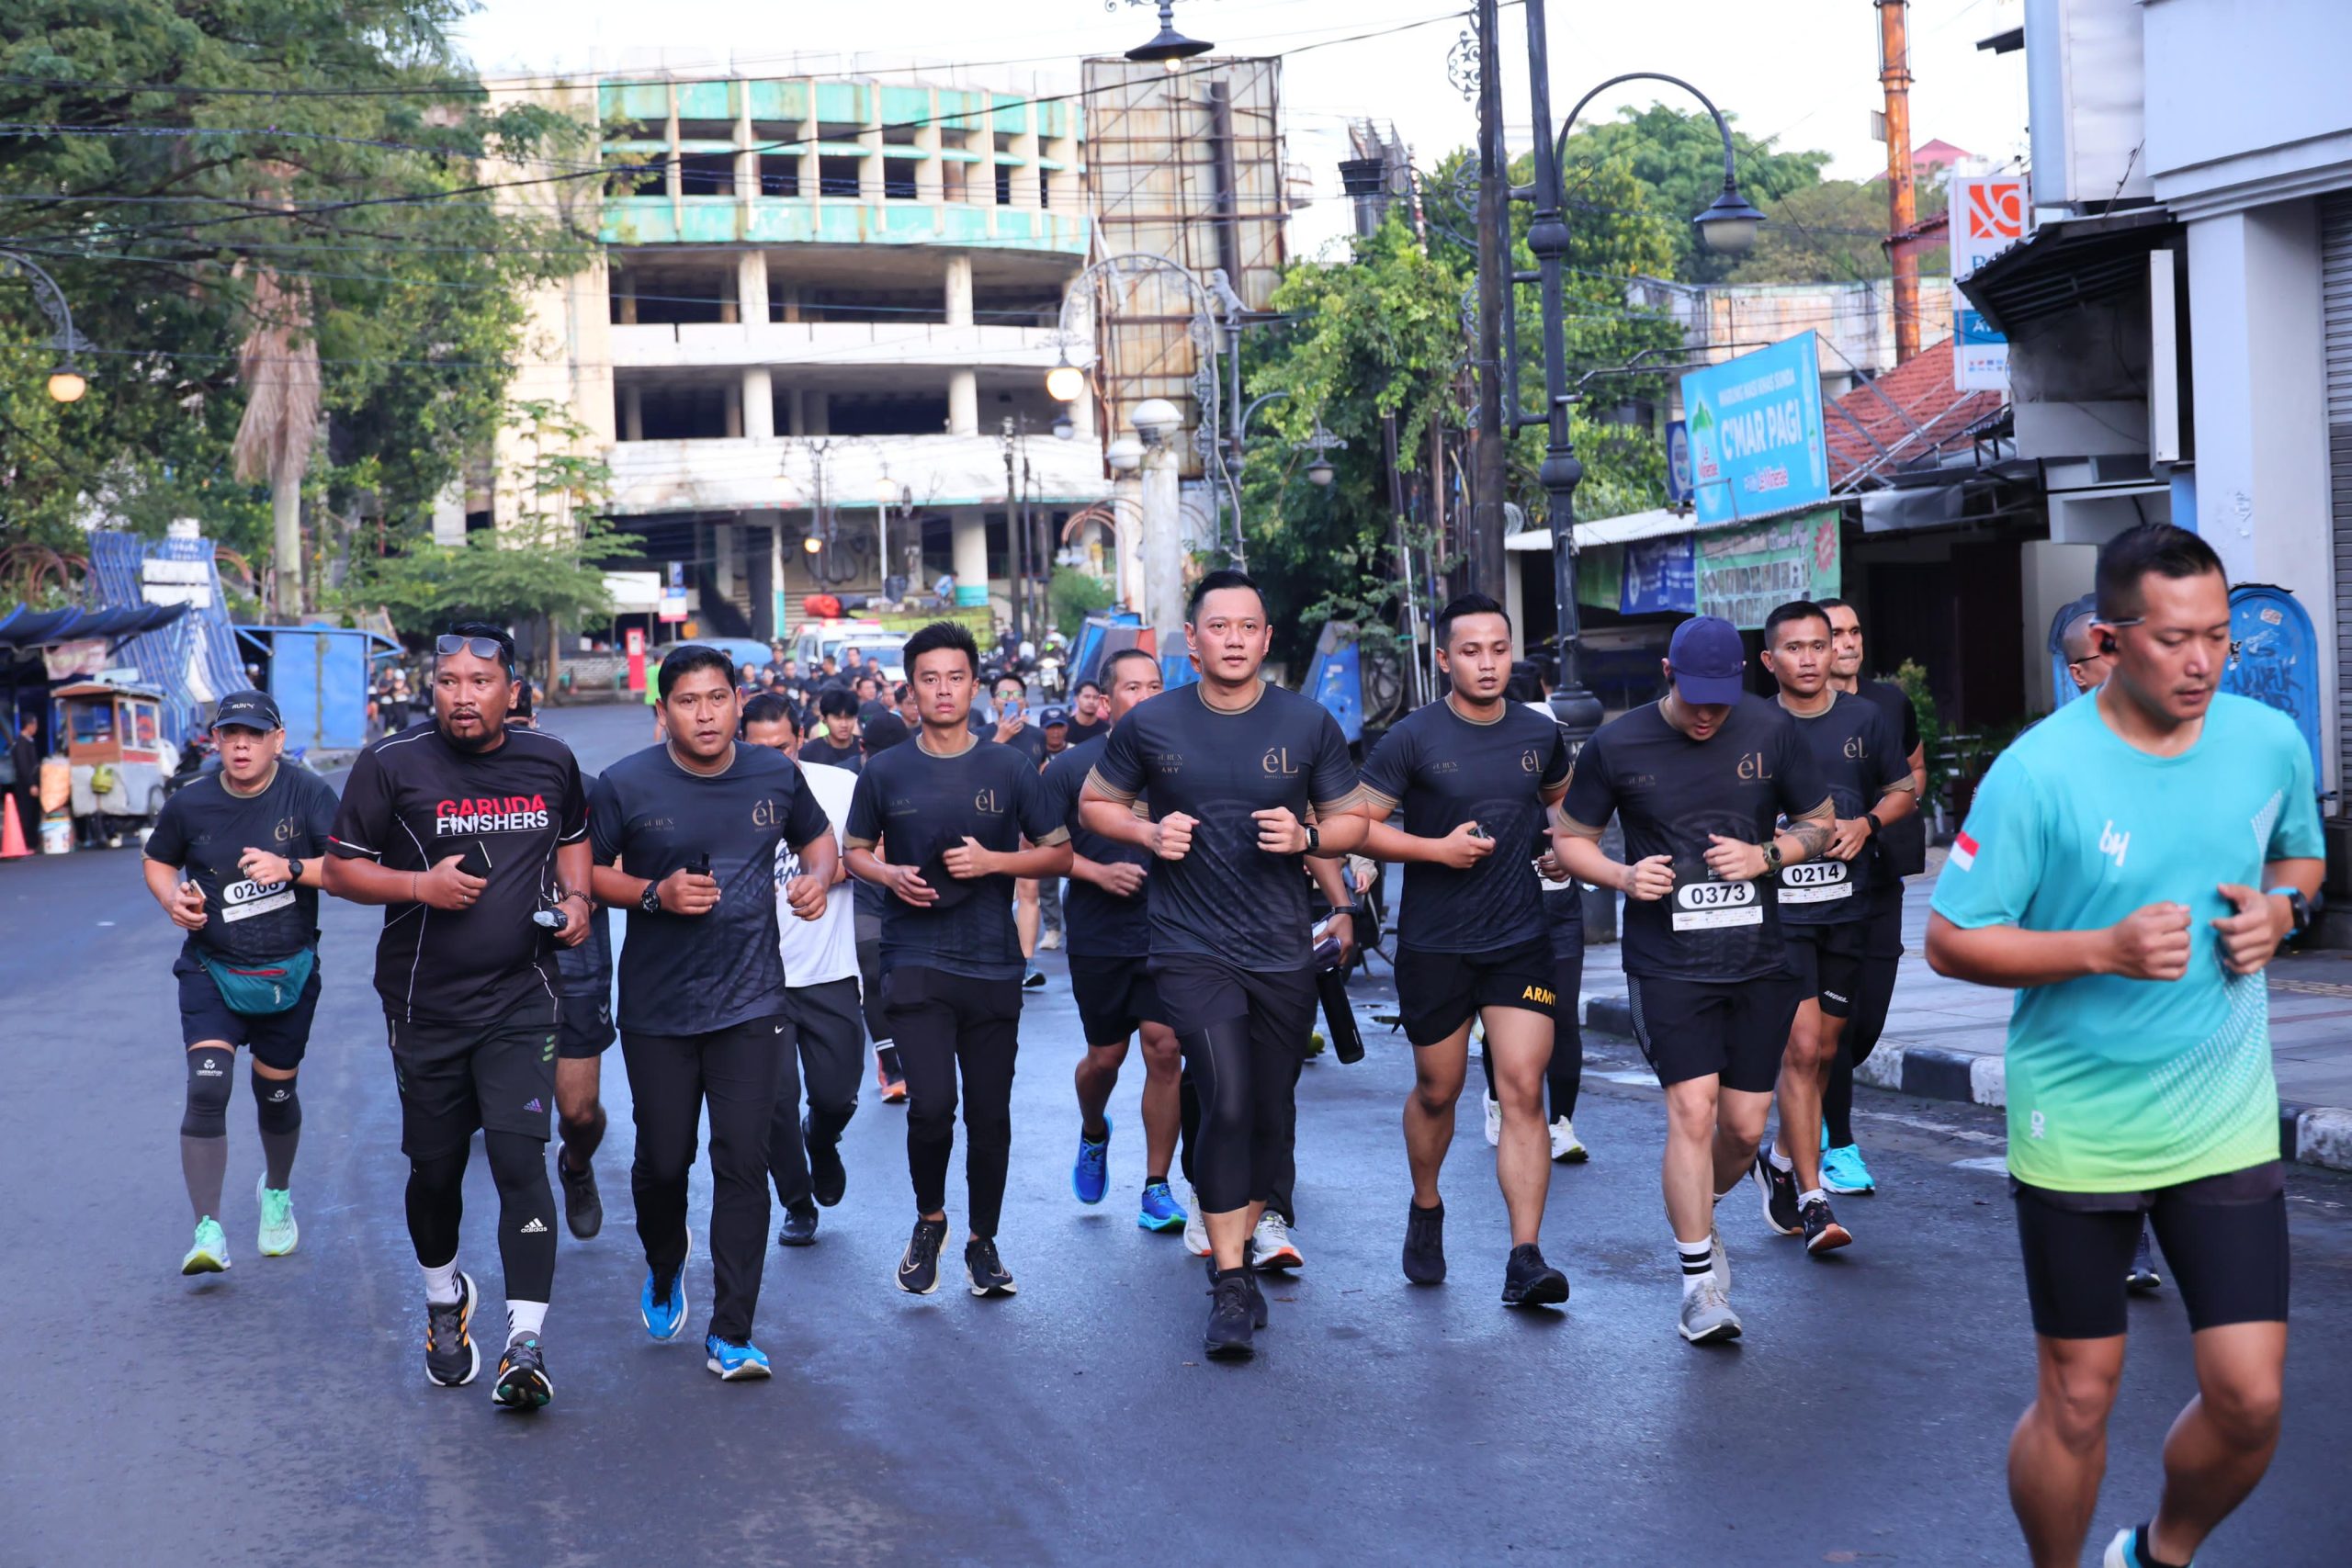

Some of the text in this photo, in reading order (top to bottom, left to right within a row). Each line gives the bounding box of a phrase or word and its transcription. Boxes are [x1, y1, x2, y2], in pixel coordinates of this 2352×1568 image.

[1767, 399, 1802, 449] PAGI
[1262, 747, 1298, 773] éL
[1843, 736, 1868, 759] éL
[1161, 766, 1179, 774] AHY
[1737, 751, 1772, 780] éL
[436, 794, 548, 818] GARUDA
[752, 798, 782, 827] éL
[975, 788, 1004, 814] éL
[274, 816, 301, 842] éL
[436, 809, 549, 836] FINISHERS
[1792, 864, 1839, 884] 0214
[1690, 884, 1746, 905] 0373
[1521, 985, 1556, 1008] ARMY
